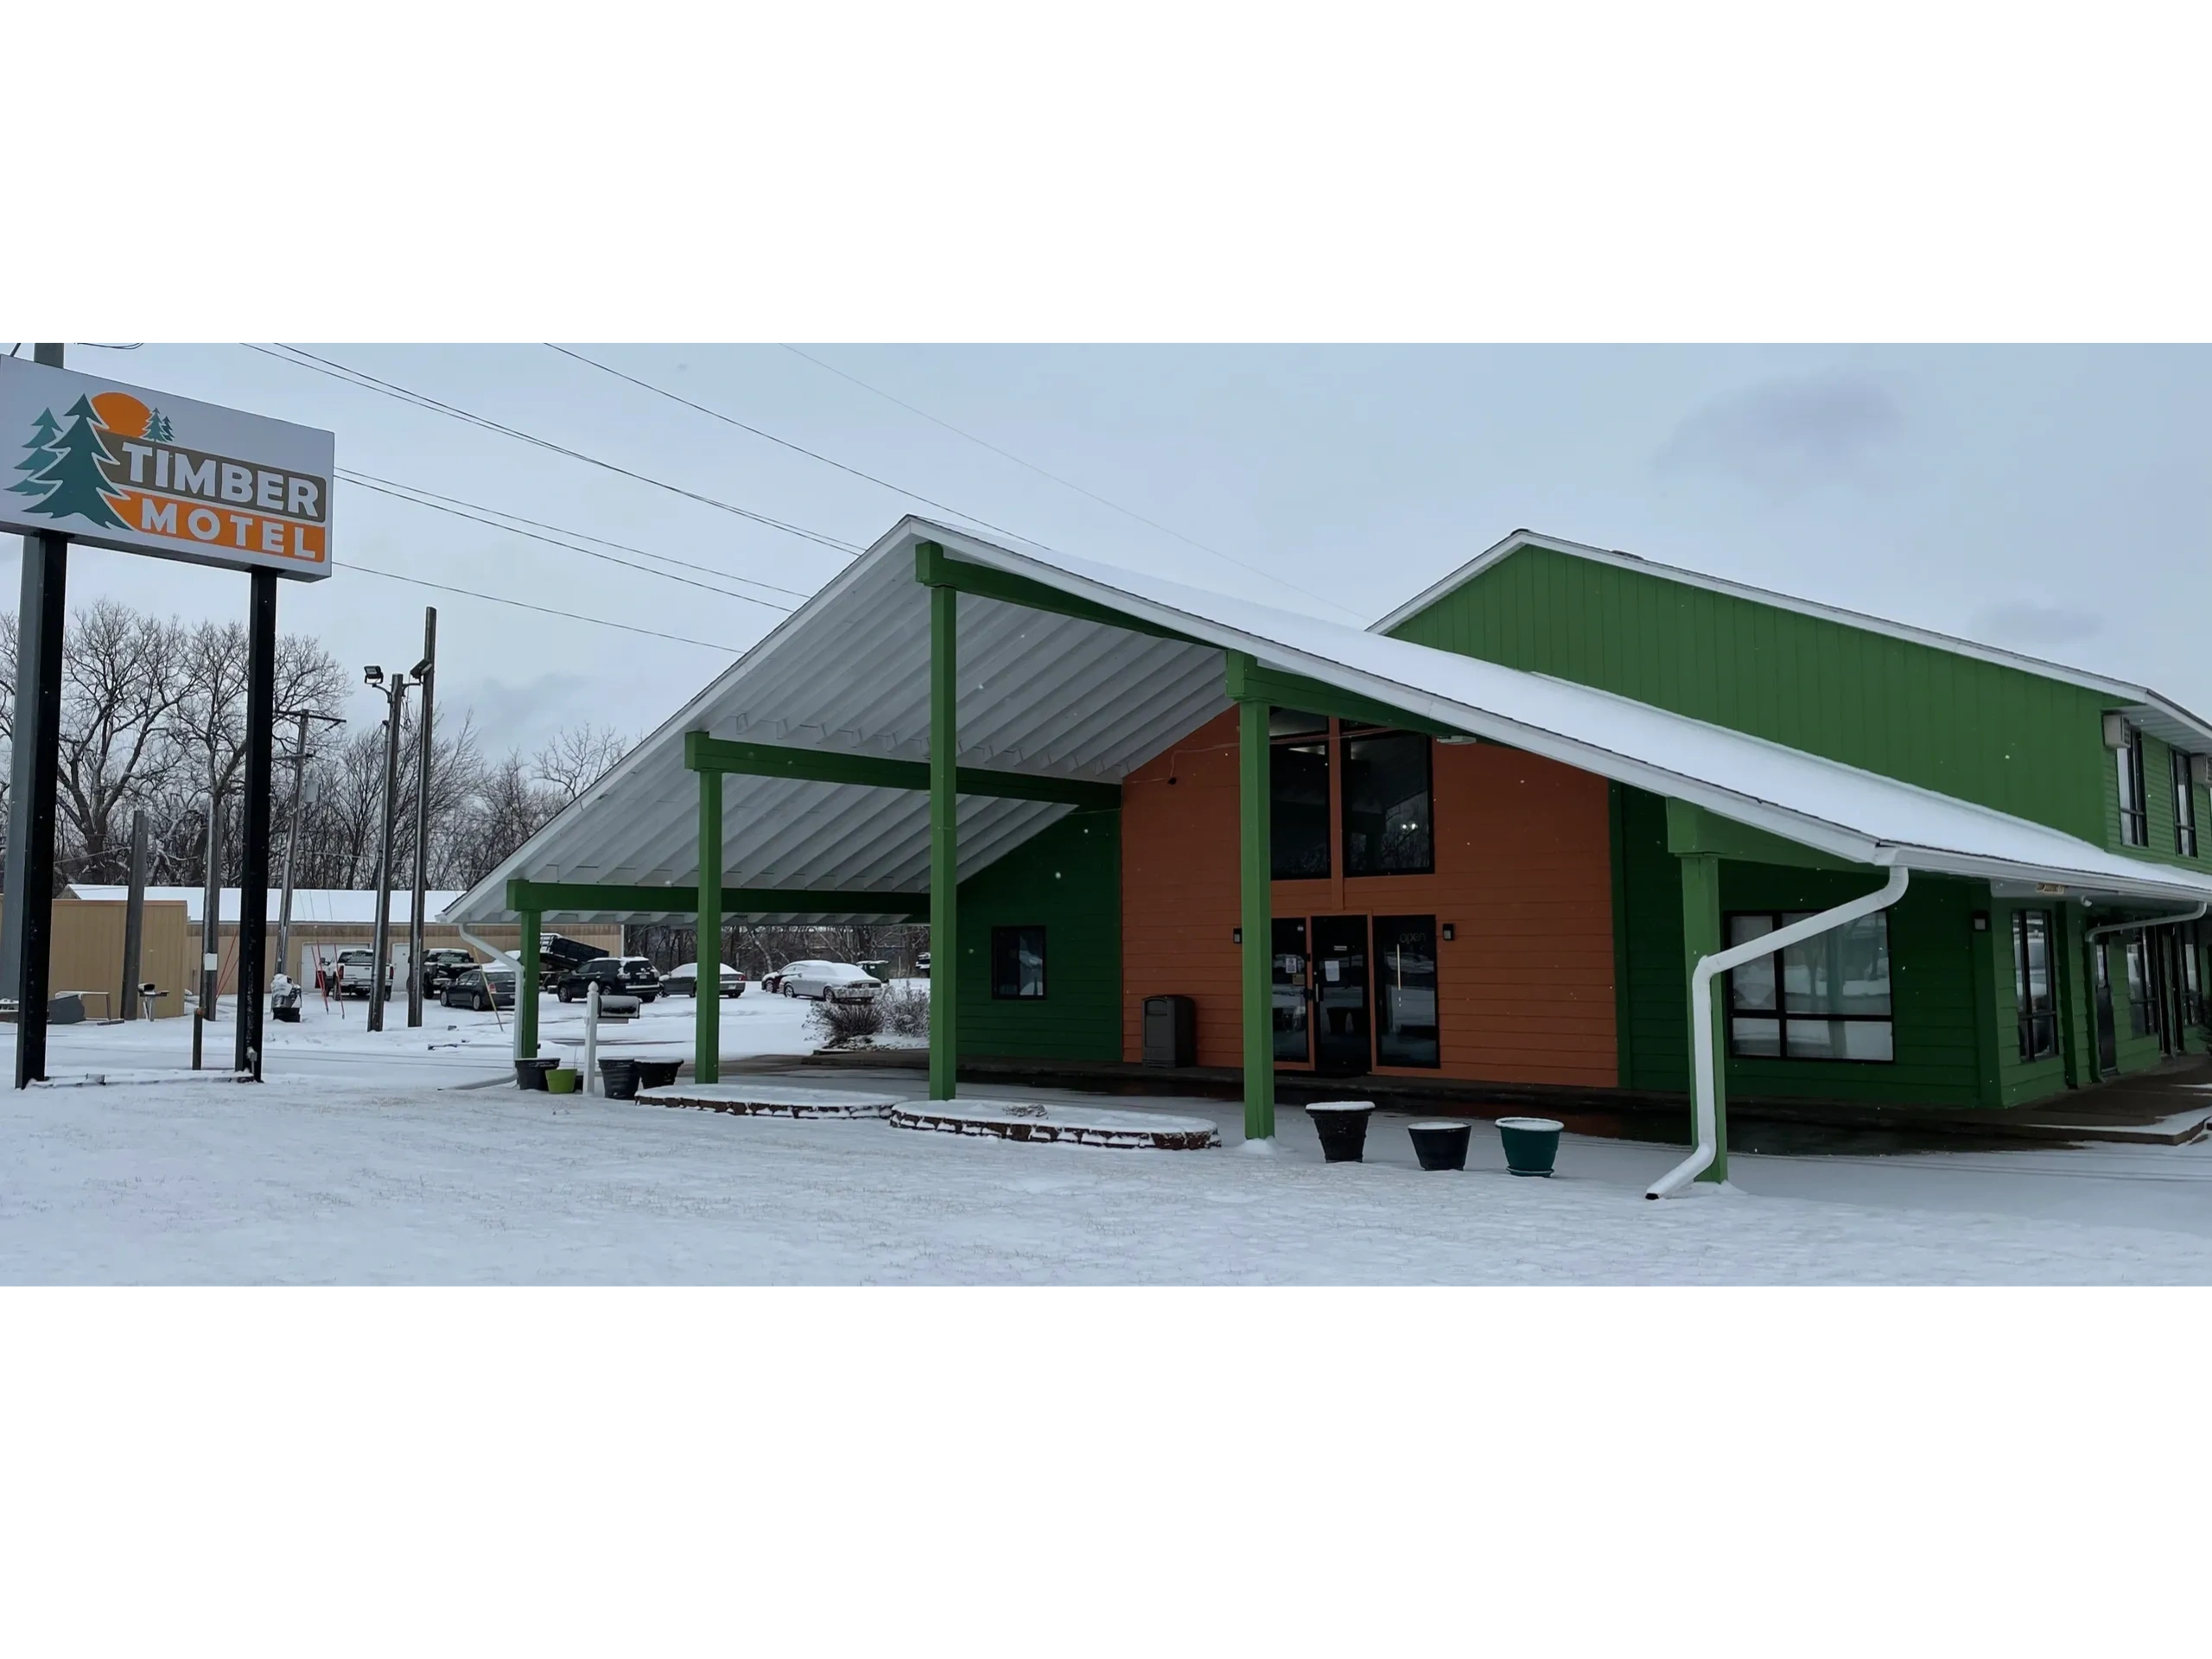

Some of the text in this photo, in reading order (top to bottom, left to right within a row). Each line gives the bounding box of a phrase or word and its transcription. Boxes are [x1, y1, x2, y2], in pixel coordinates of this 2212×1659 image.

[122, 442, 319, 518] TIMBER
[141, 499, 316, 559] MOTEL
[1399, 932, 1426, 944] open
